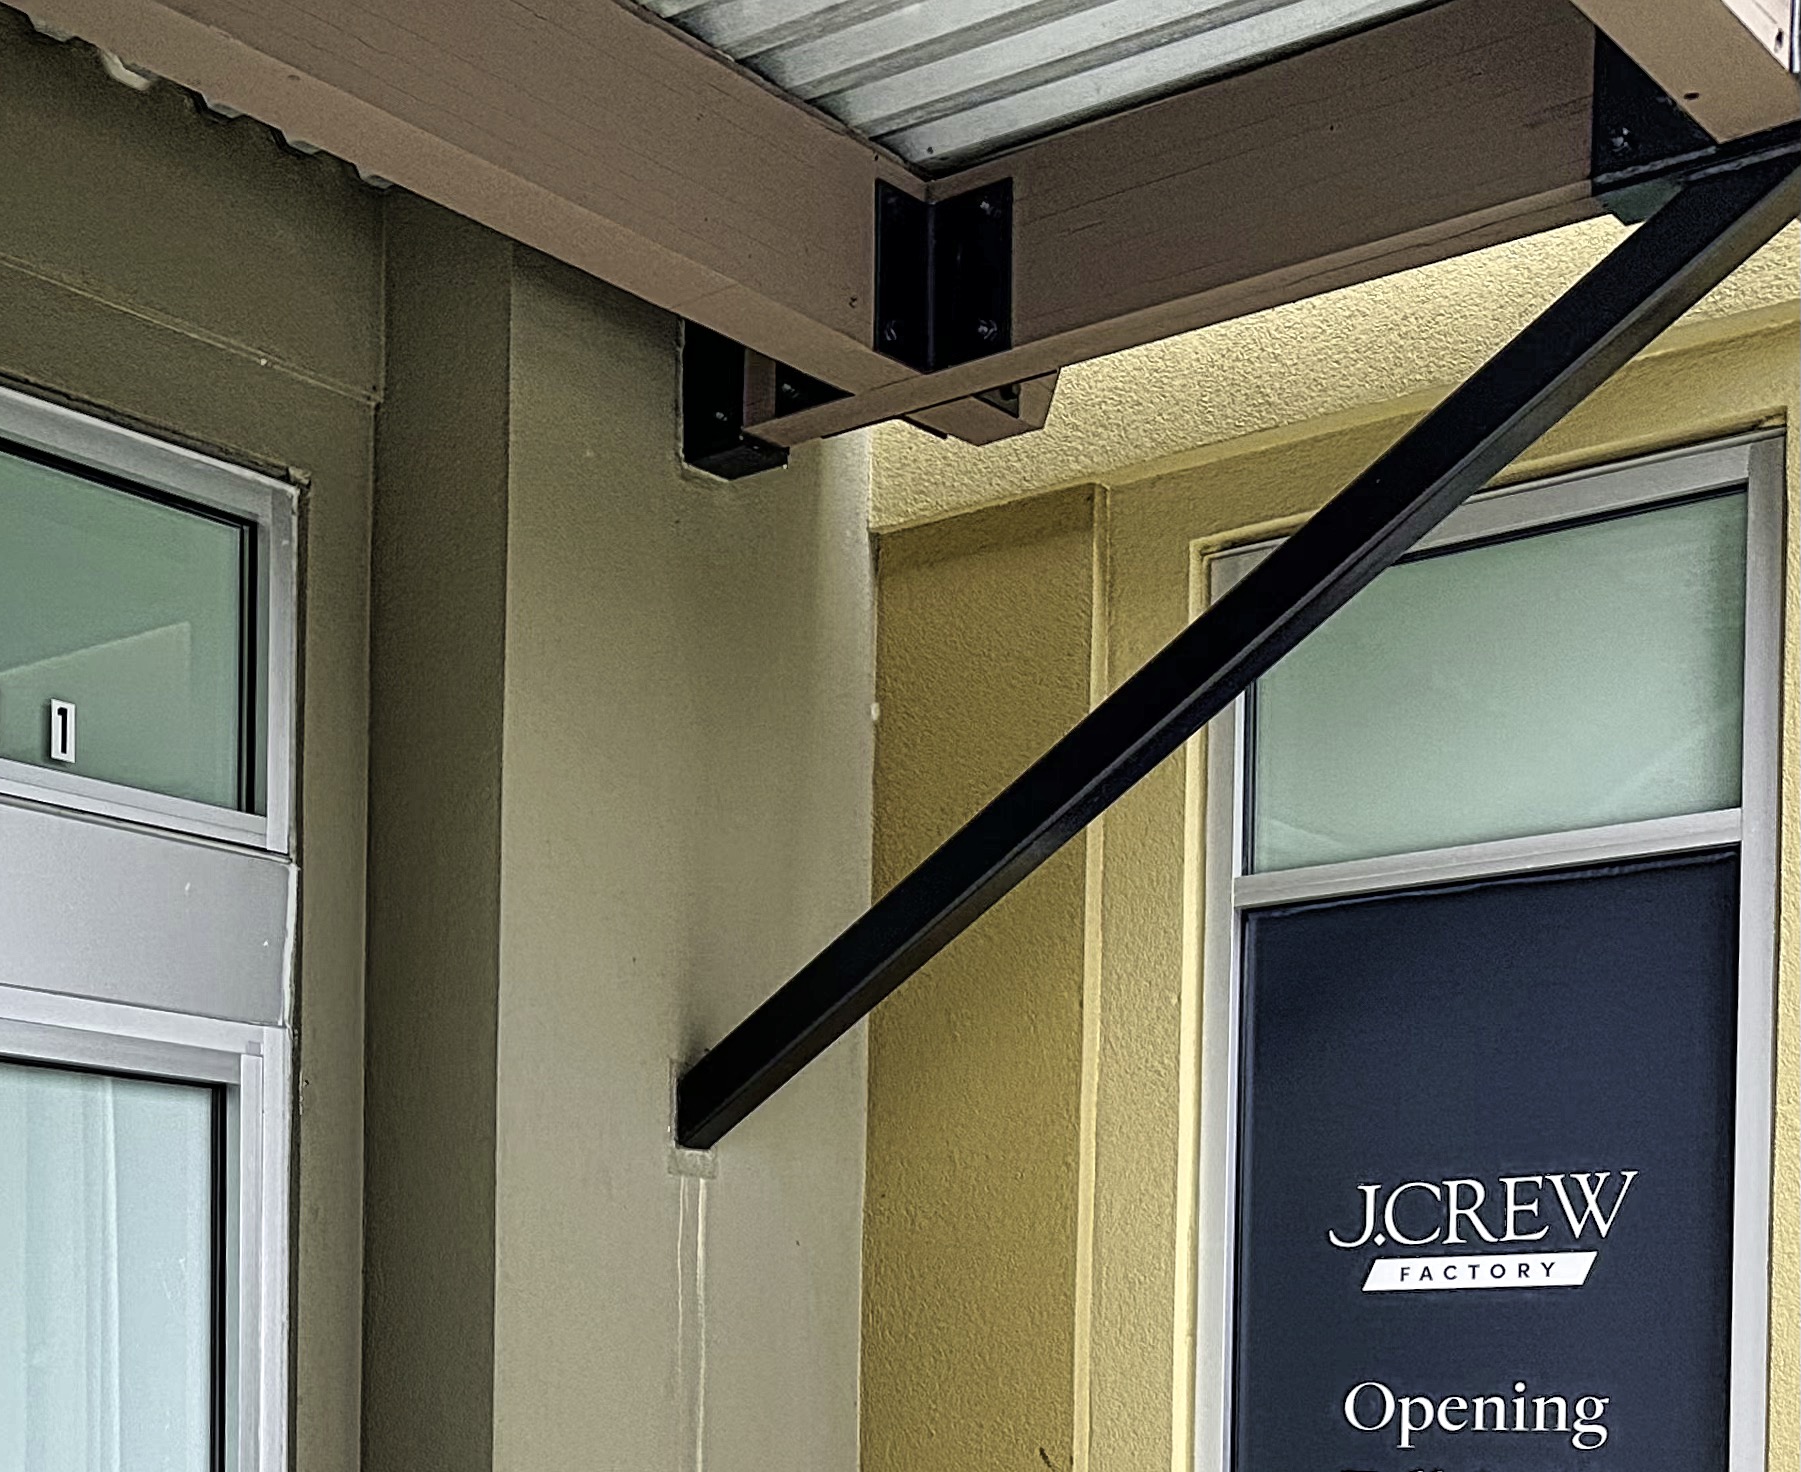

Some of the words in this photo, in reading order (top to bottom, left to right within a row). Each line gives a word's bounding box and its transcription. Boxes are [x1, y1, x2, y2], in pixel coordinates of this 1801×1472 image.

[57, 706, 68, 754] 1
[1328, 1170, 1639, 1249] J.CREW
[1399, 1260, 1559, 1283] FACTORY
[1343, 1381, 1610, 1450] Opening
